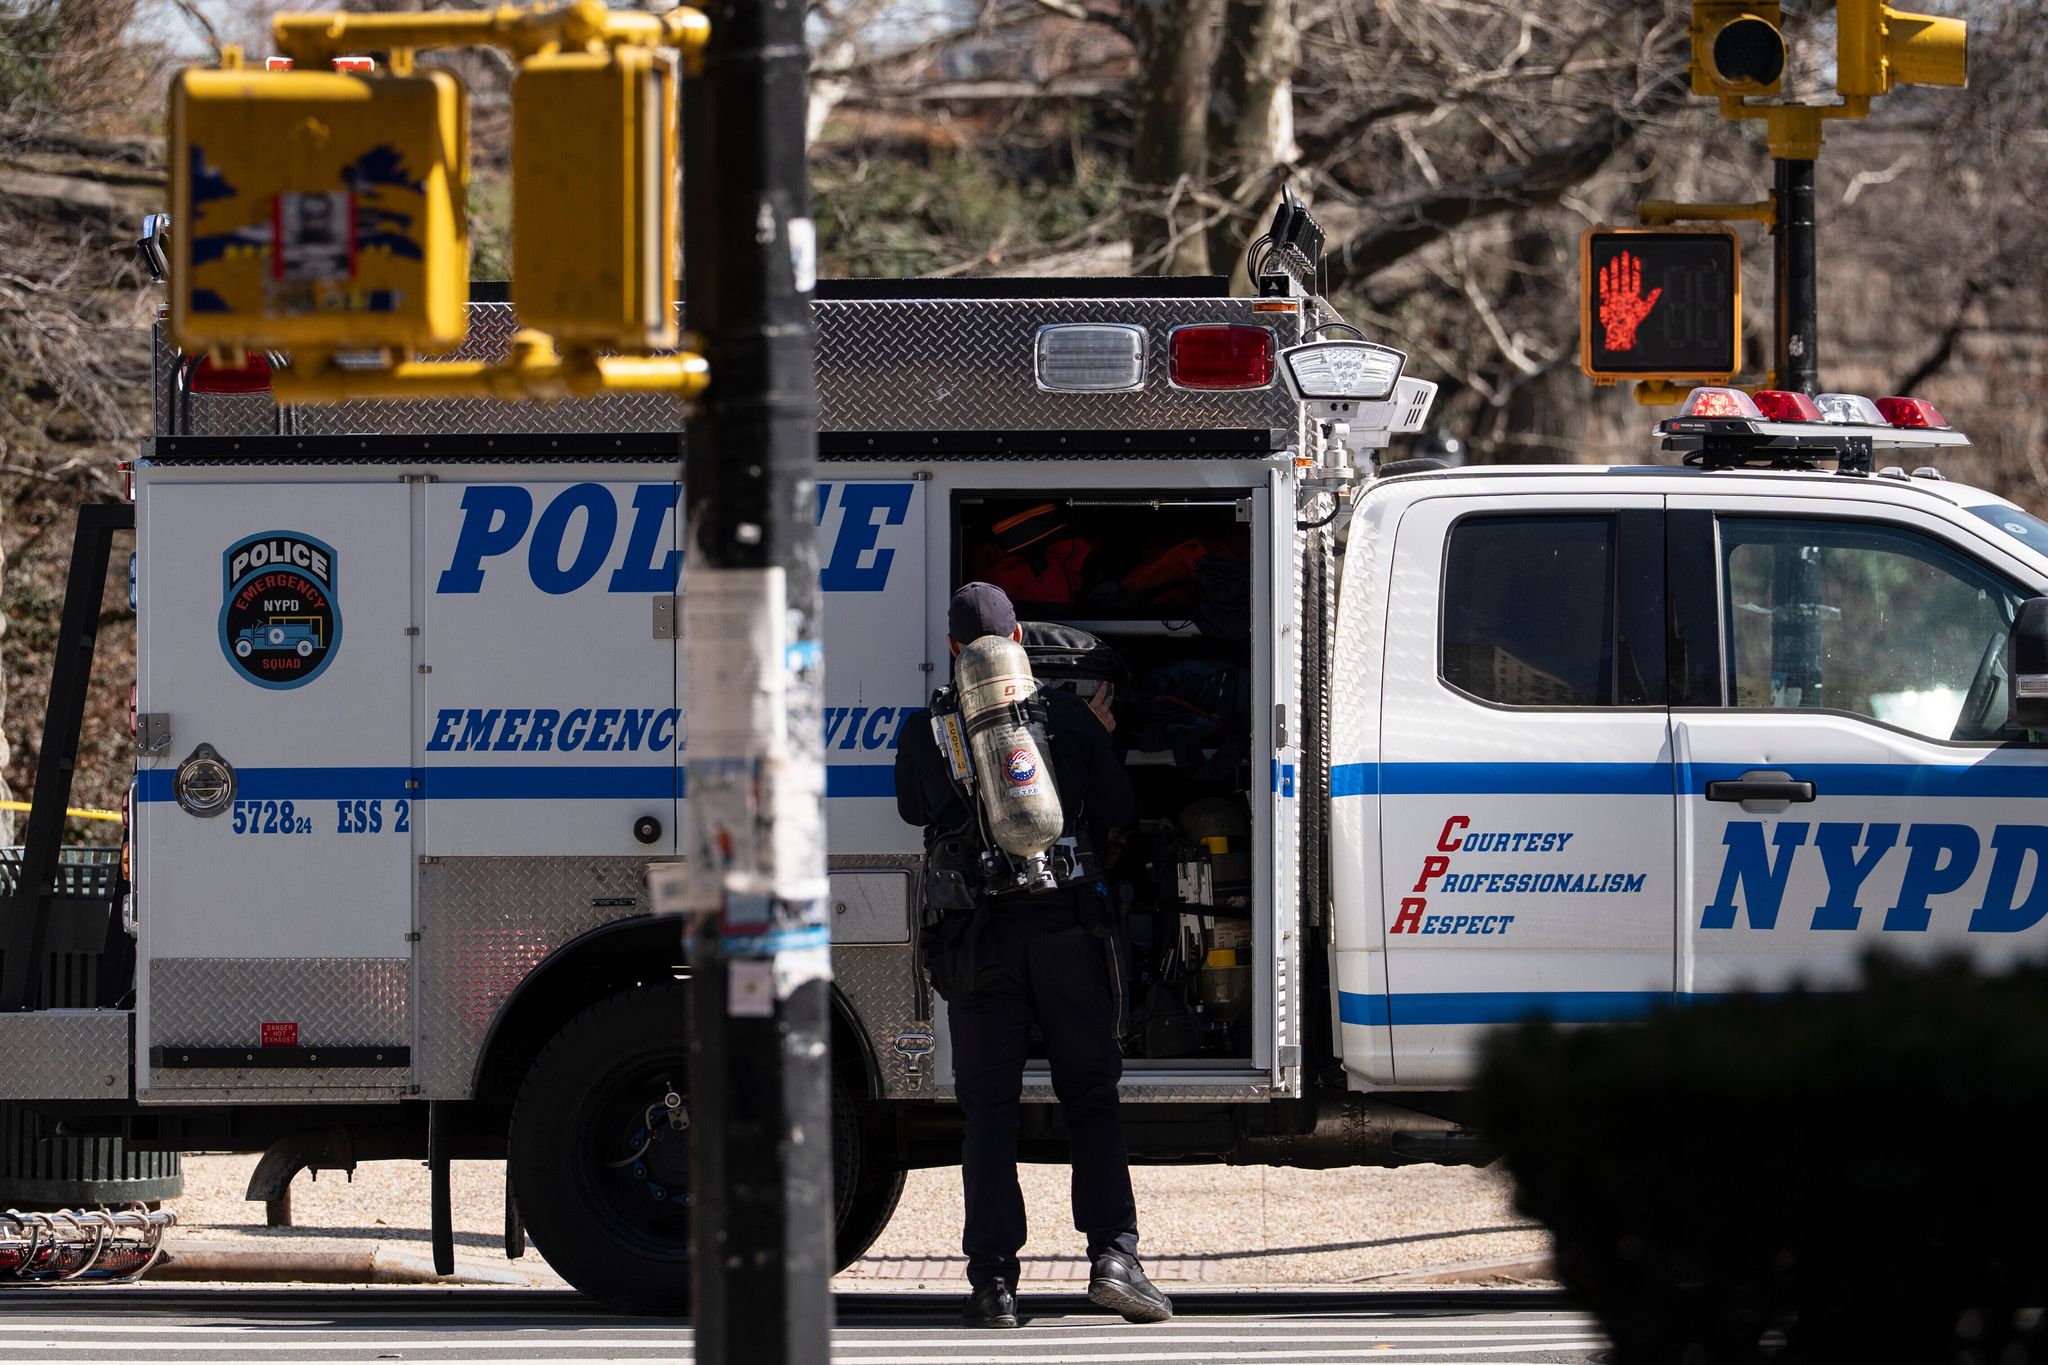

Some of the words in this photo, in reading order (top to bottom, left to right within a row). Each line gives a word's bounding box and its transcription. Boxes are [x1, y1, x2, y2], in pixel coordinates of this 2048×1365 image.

[436, 482, 915, 595] POLE
[232, 541, 328, 583] POLICE
[235, 574, 325, 611] EMERGENCY
[263, 599, 300, 612] NYPD
[262, 658, 301, 670] SQUAD
[426, 707, 688, 753] EMERGENC
[948, 721, 961, 757] SCOTT
[336, 800, 383, 834] ESS
[394, 800, 410, 833] 2
[1436, 815, 1573, 852] COURTESY
[1412, 855, 1647, 893] PROFESSIONALISM
[1700, 820, 2048, 933] NYPD
[1389, 896, 1515, 935] RESPECT
